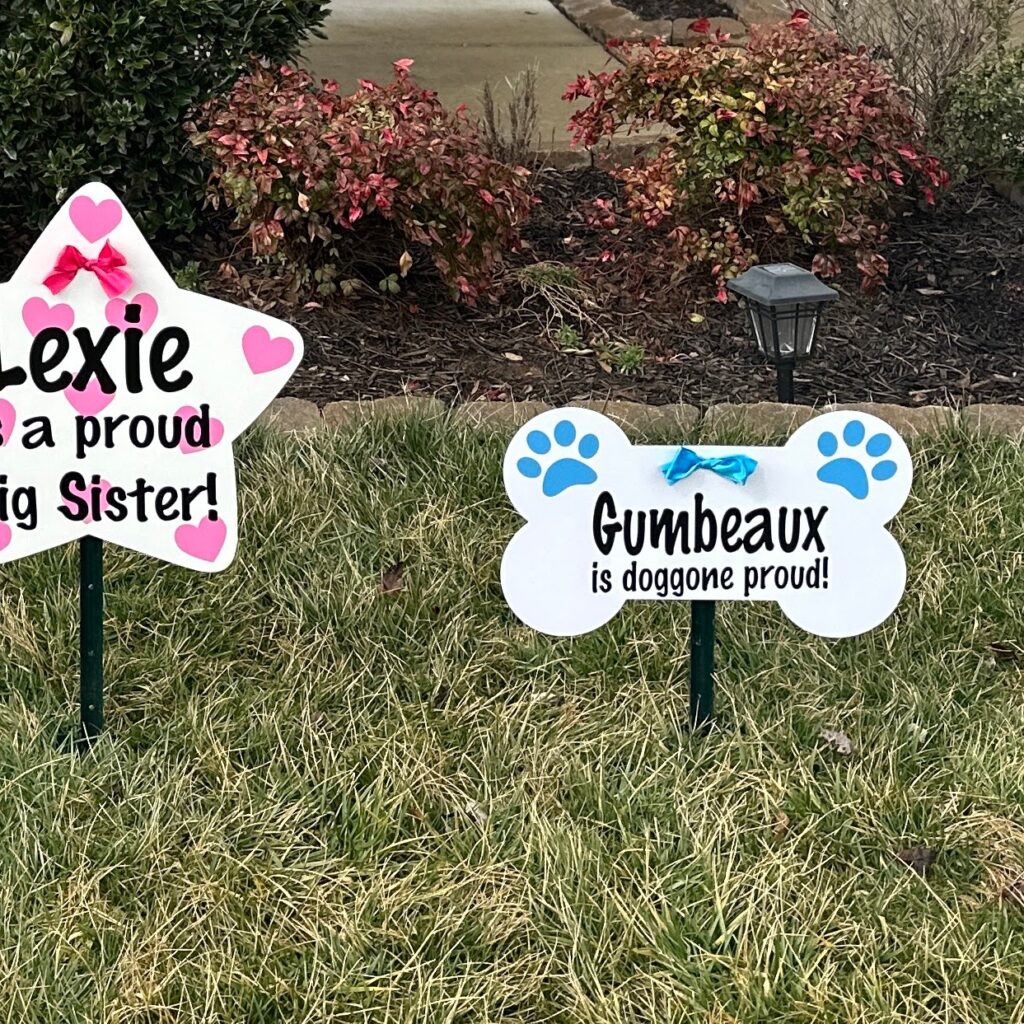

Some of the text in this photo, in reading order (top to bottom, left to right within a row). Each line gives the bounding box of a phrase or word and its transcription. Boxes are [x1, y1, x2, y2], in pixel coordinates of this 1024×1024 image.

[21, 415, 56, 450] a
[74, 403, 212, 460] proud
[56, 470, 219, 523] Sister!
[592, 490, 829, 557] Gumbeaux
[591, 556, 829, 598] is doggone proud!
